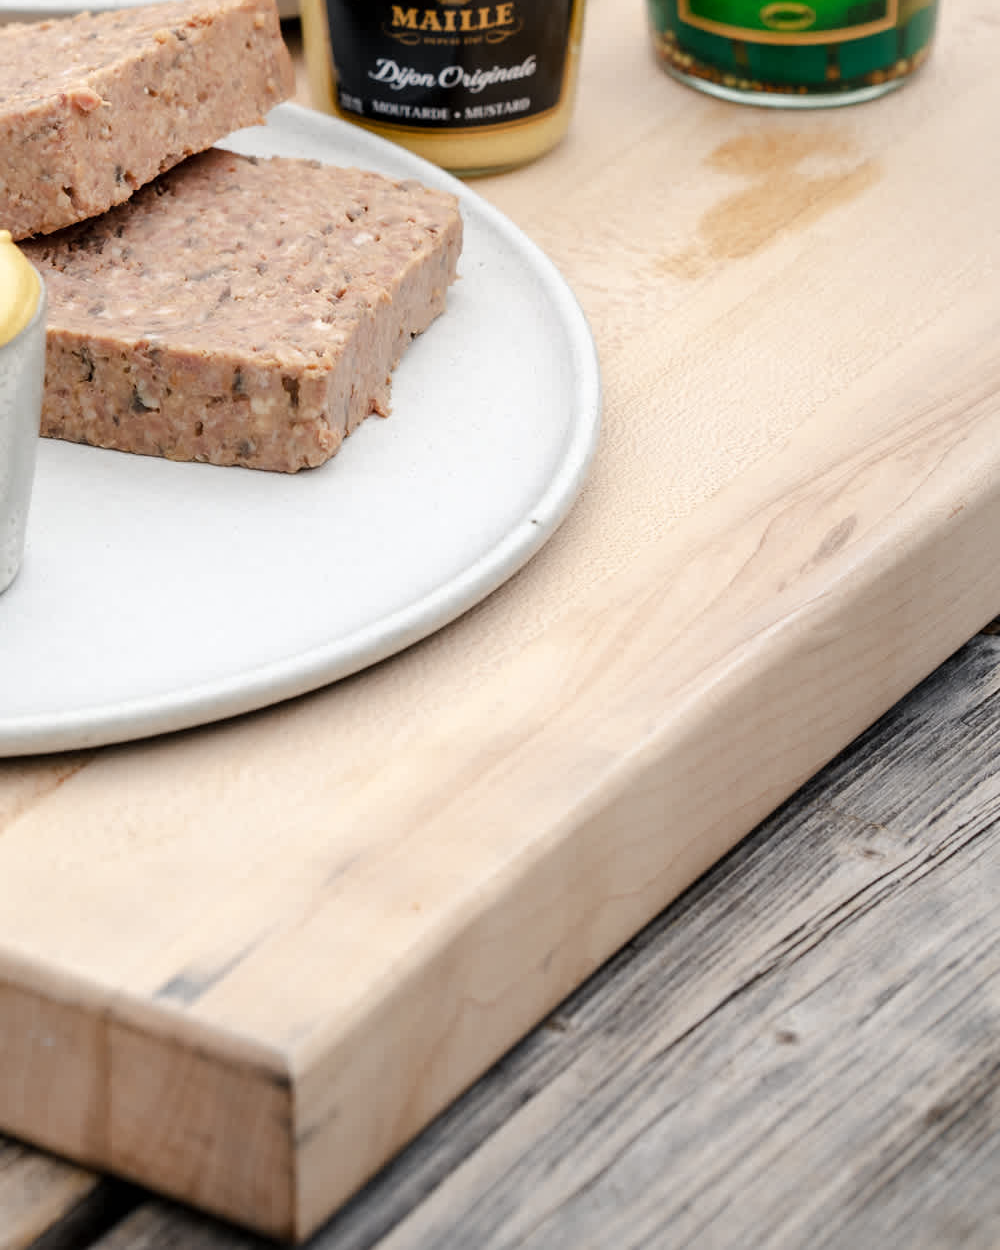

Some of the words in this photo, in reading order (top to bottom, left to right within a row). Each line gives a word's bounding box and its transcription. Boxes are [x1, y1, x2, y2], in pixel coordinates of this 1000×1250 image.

[391, 2, 514, 32] MAILLE
[368, 58, 437, 90] Dijon
[438, 54, 537, 94] Originale
[371, 99, 449, 121] MOUTARDE
[464, 97, 531, 120] MUSTARD
